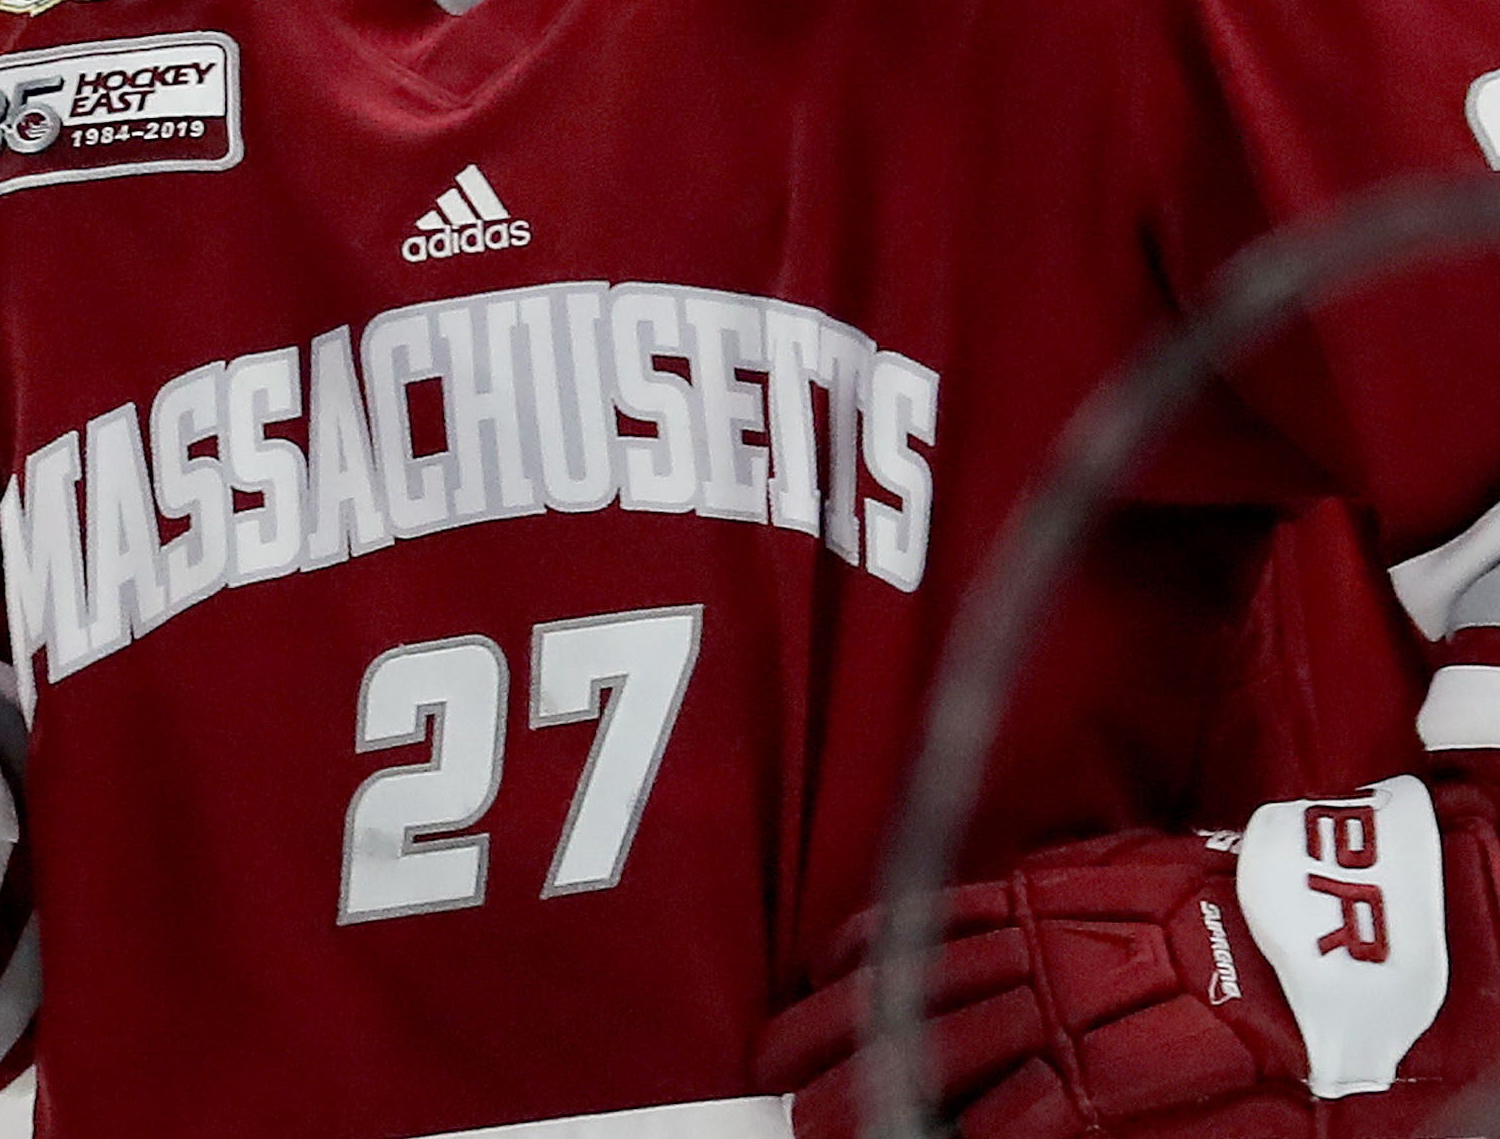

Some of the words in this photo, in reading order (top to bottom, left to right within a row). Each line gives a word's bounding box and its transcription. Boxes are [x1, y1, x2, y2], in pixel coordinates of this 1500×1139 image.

[74, 62, 216, 96] HOCKEY
[68, 89, 156, 119] EAST
[70, 120, 206, 148] 1984-2019
[401, 218, 532, 263] adidas
[0, 280, 941, 734] MASSACHUSETTS
[335, 602, 705, 927] 27
